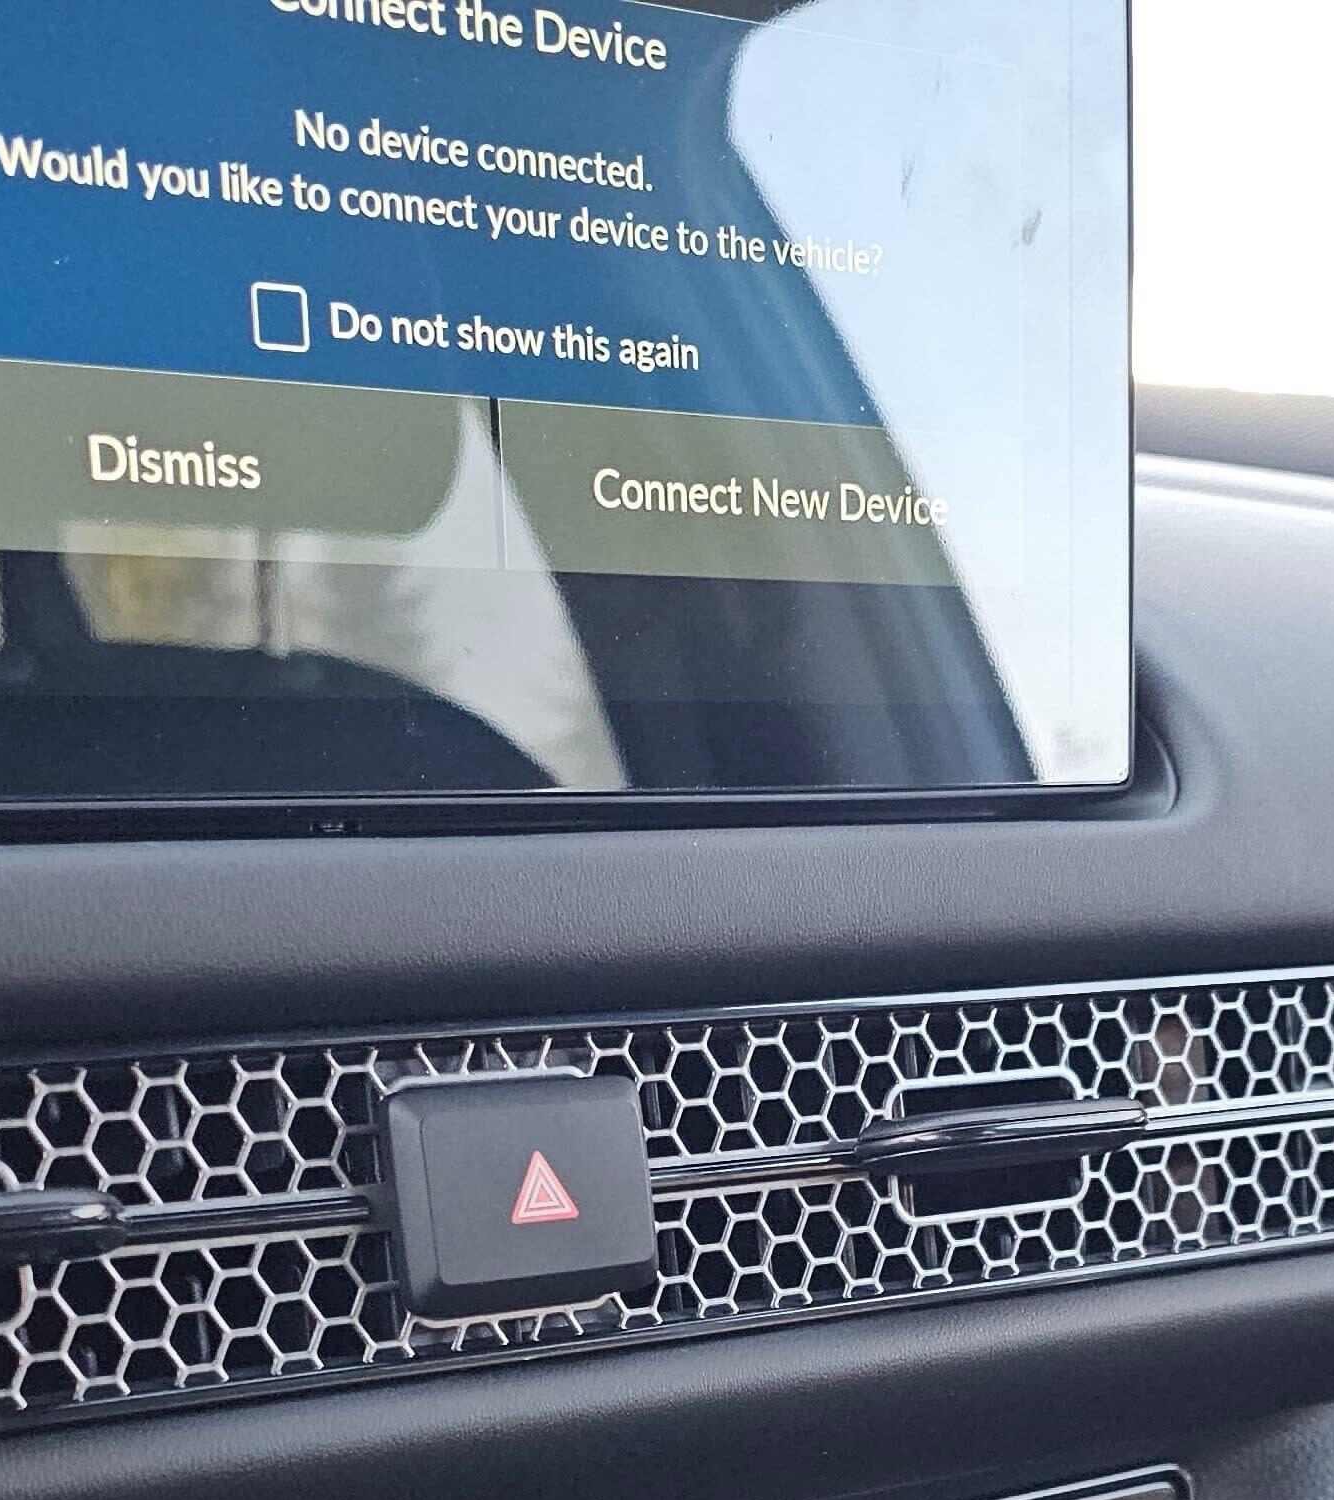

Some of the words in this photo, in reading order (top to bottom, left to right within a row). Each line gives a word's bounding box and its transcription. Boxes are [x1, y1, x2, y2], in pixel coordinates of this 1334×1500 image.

[271, 0, 447, 36] onnect
[456, 0, 523, 48] the
[534, 9, 668, 71] Device
[294, 108, 350, 153] No
[358, 117, 469, 169] device
[476, 142, 653, 192] connected.
[137, 161, 210, 201] you
[219, 160, 284, 207] like
[290, 172, 331, 213] to
[339, 187, 479, 232] connect
[484, 203, 562, 241] your
[569, 206, 669, 252] device
[676, 221, 709, 257] to
[716, 225, 766, 263] the
[771, 234, 884, 276] vehicle?
[329, 301, 383, 342] Do
[391, 313, 450, 349] not
[456, 315, 545, 357] show
[552, 324, 610, 363] this
[618, 335, 700, 374] again
[87, 433, 262, 490] Dismiss
[592, 468, 744, 516] Connect
[751, 477, 831, 522] New
[839, 482, 950, 527] Device
